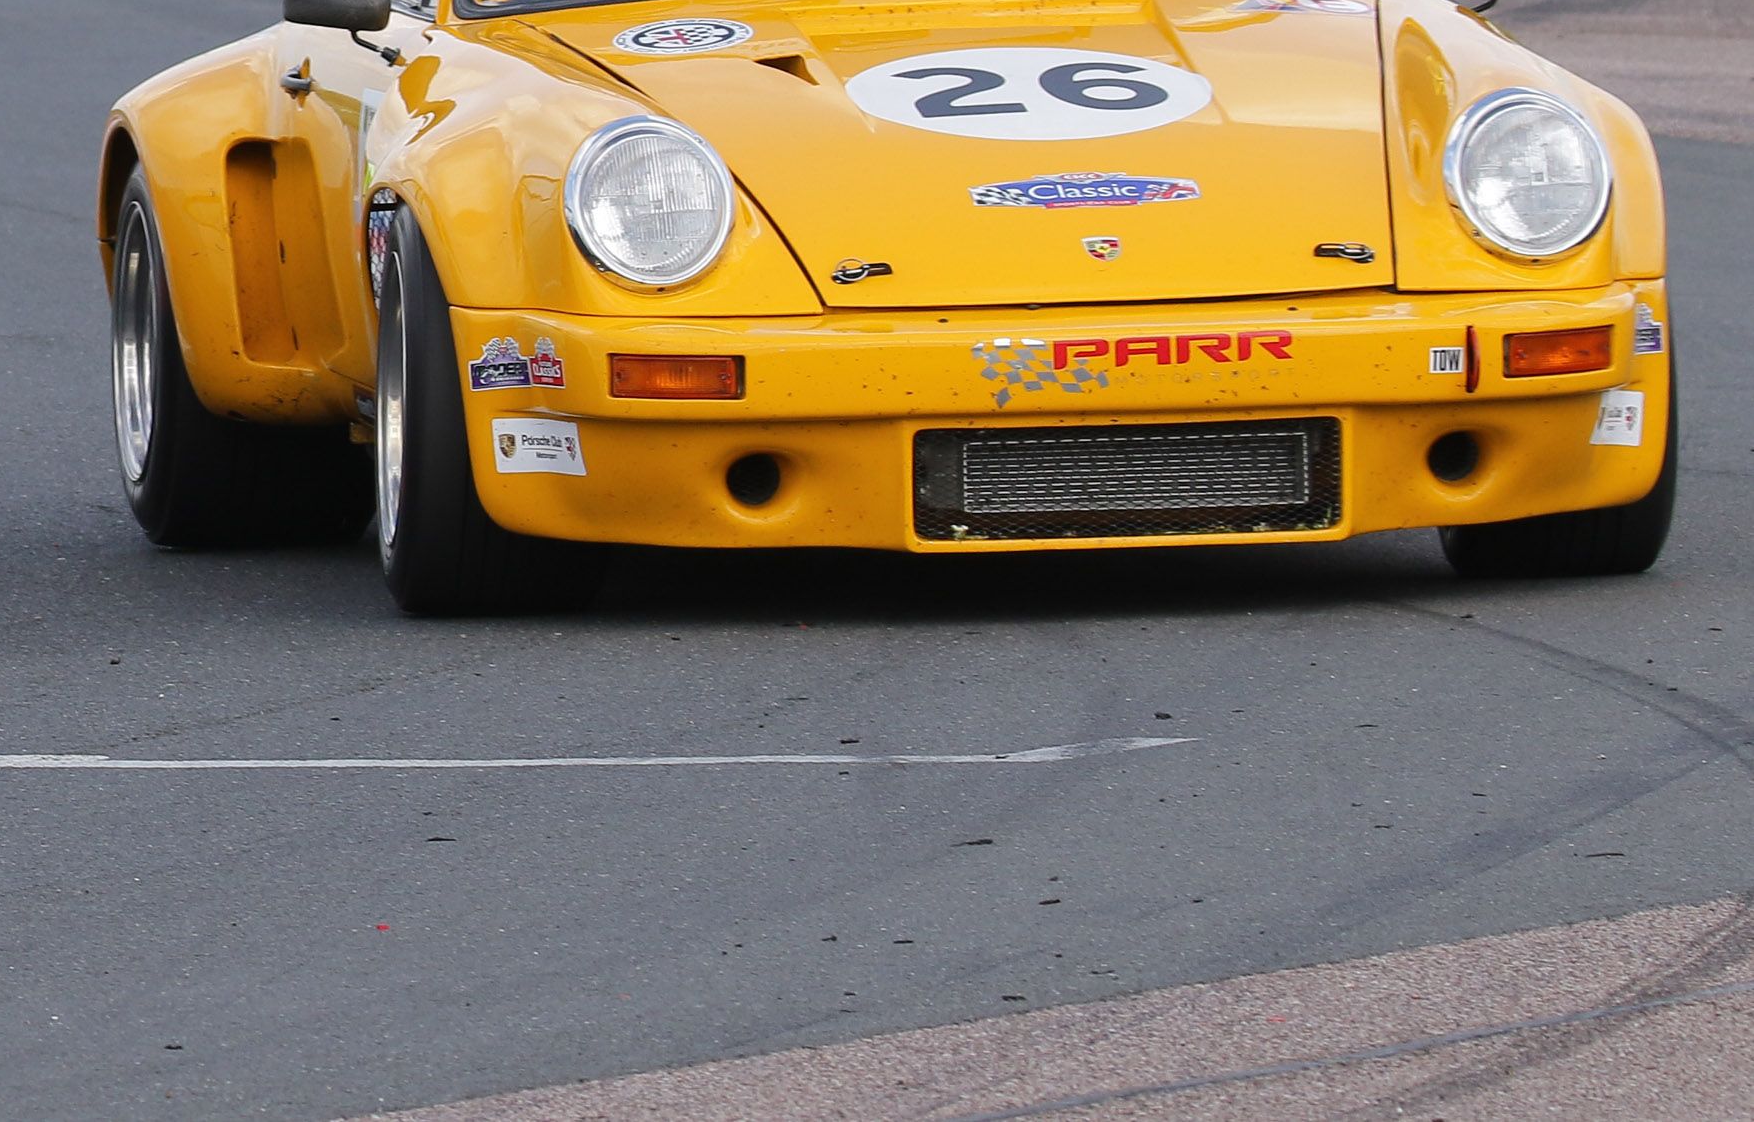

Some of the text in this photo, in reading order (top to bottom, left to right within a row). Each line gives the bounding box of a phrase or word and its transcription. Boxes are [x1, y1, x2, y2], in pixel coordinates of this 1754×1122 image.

[890, 62, 1170, 119] 26
[1028, 183, 1140, 199] Classic
[1053, 330, 1293, 370] PARR
[1432, 349, 1461, 371] TOW
